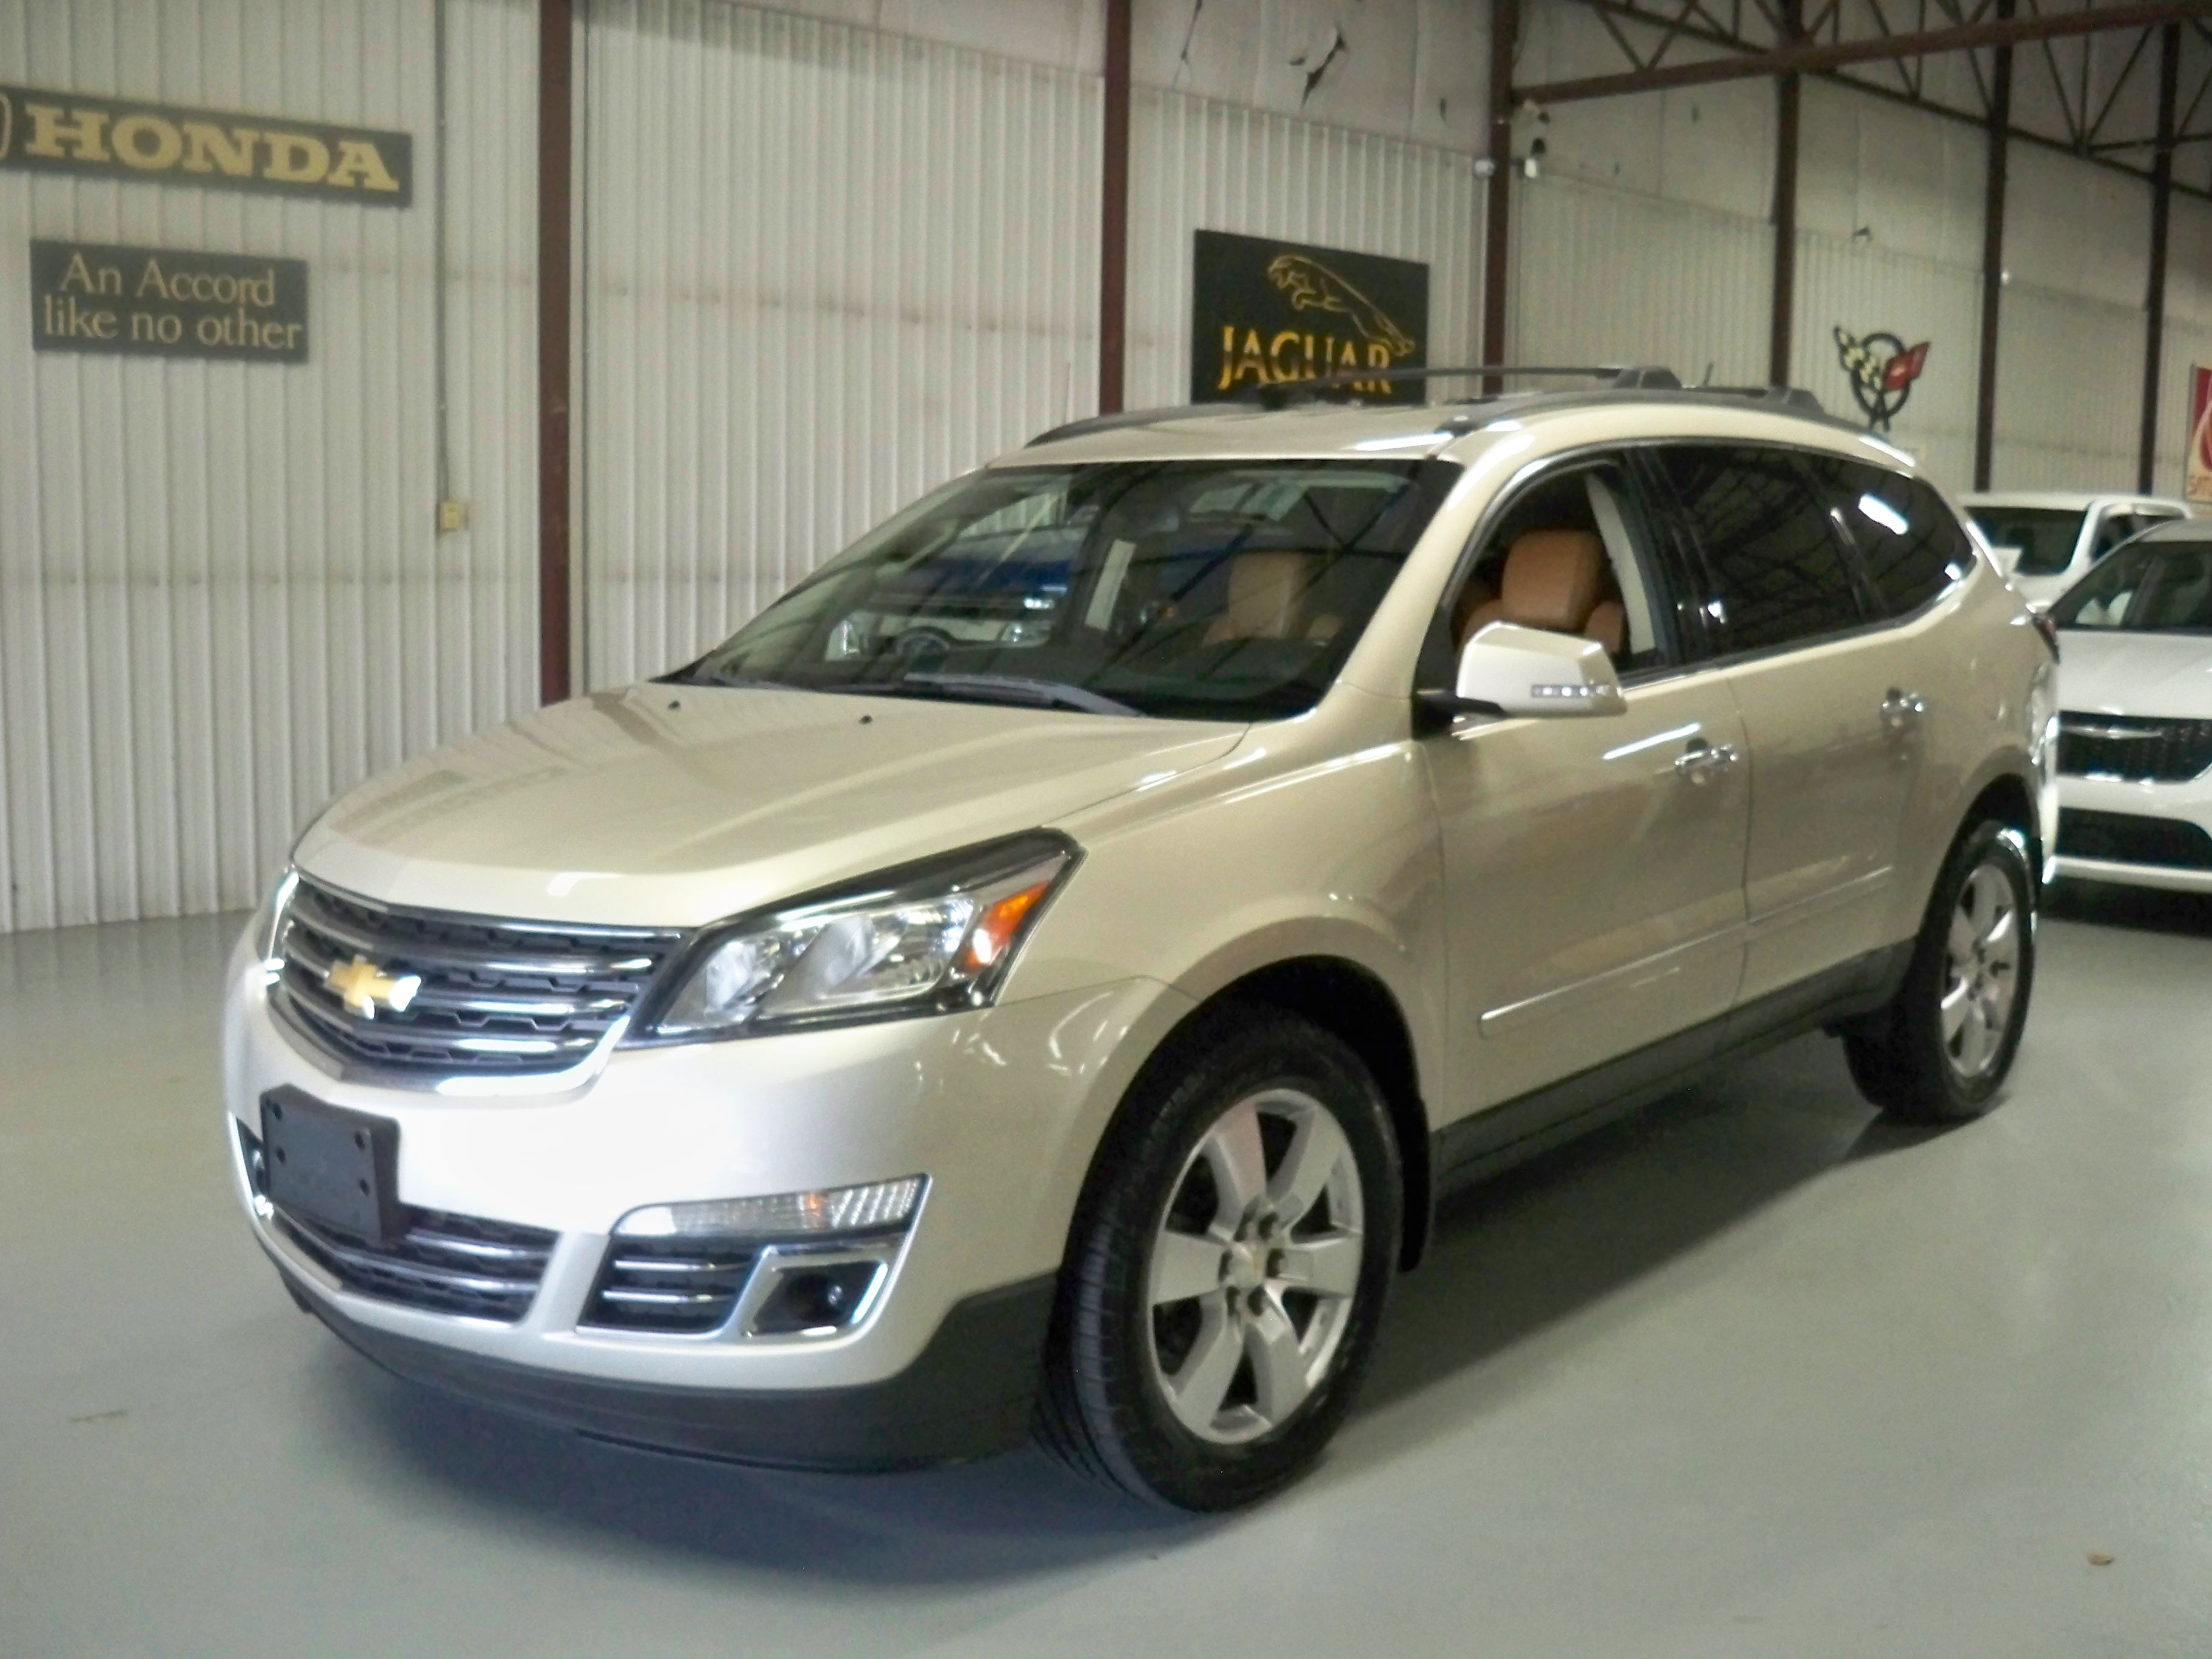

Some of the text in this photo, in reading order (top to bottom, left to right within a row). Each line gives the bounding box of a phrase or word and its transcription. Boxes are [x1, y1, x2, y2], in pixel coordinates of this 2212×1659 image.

[24, 102, 400, 193] HONDA
[61, 251, 275, 307] An Accord
[44, 293, 303, 350] like no other
[1218, 326, 1393, 395] JAGUAR
